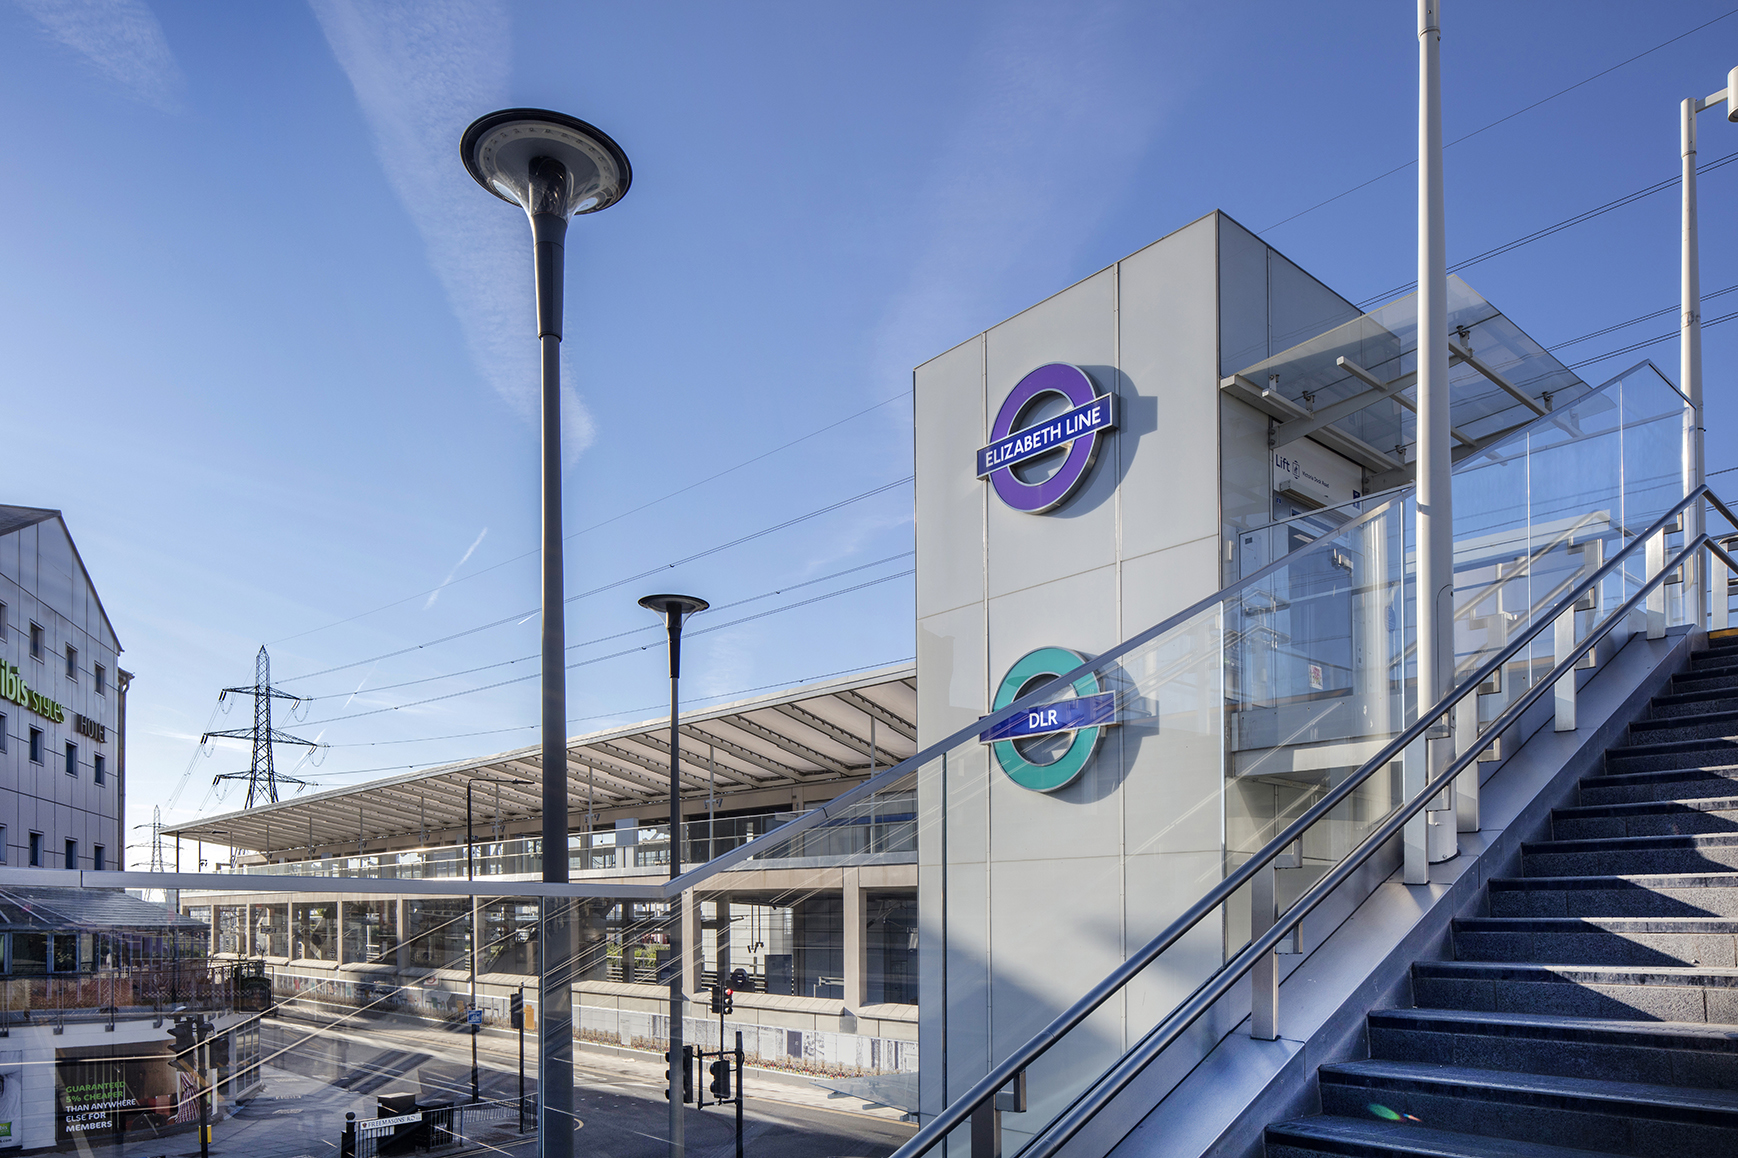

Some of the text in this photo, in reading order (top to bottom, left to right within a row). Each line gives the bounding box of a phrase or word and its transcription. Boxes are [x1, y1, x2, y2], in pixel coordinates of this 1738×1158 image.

[985, 406, 1101, 467] ELIZABETH LINE
[1275, 454, 1290, 473] Lift
[1029, 709, 1058, 729] DLR
[66, 1081, 126, 1093] GUARANTEED
[66, 1090, 124, 1103] 5% CHEAPER
[66, 1098, 136, 1113] THAN ANYWHERE
[66, 1111, 106, 1123] ELSE FOR
[66, 1120, 113, 1133] MEMBERS
